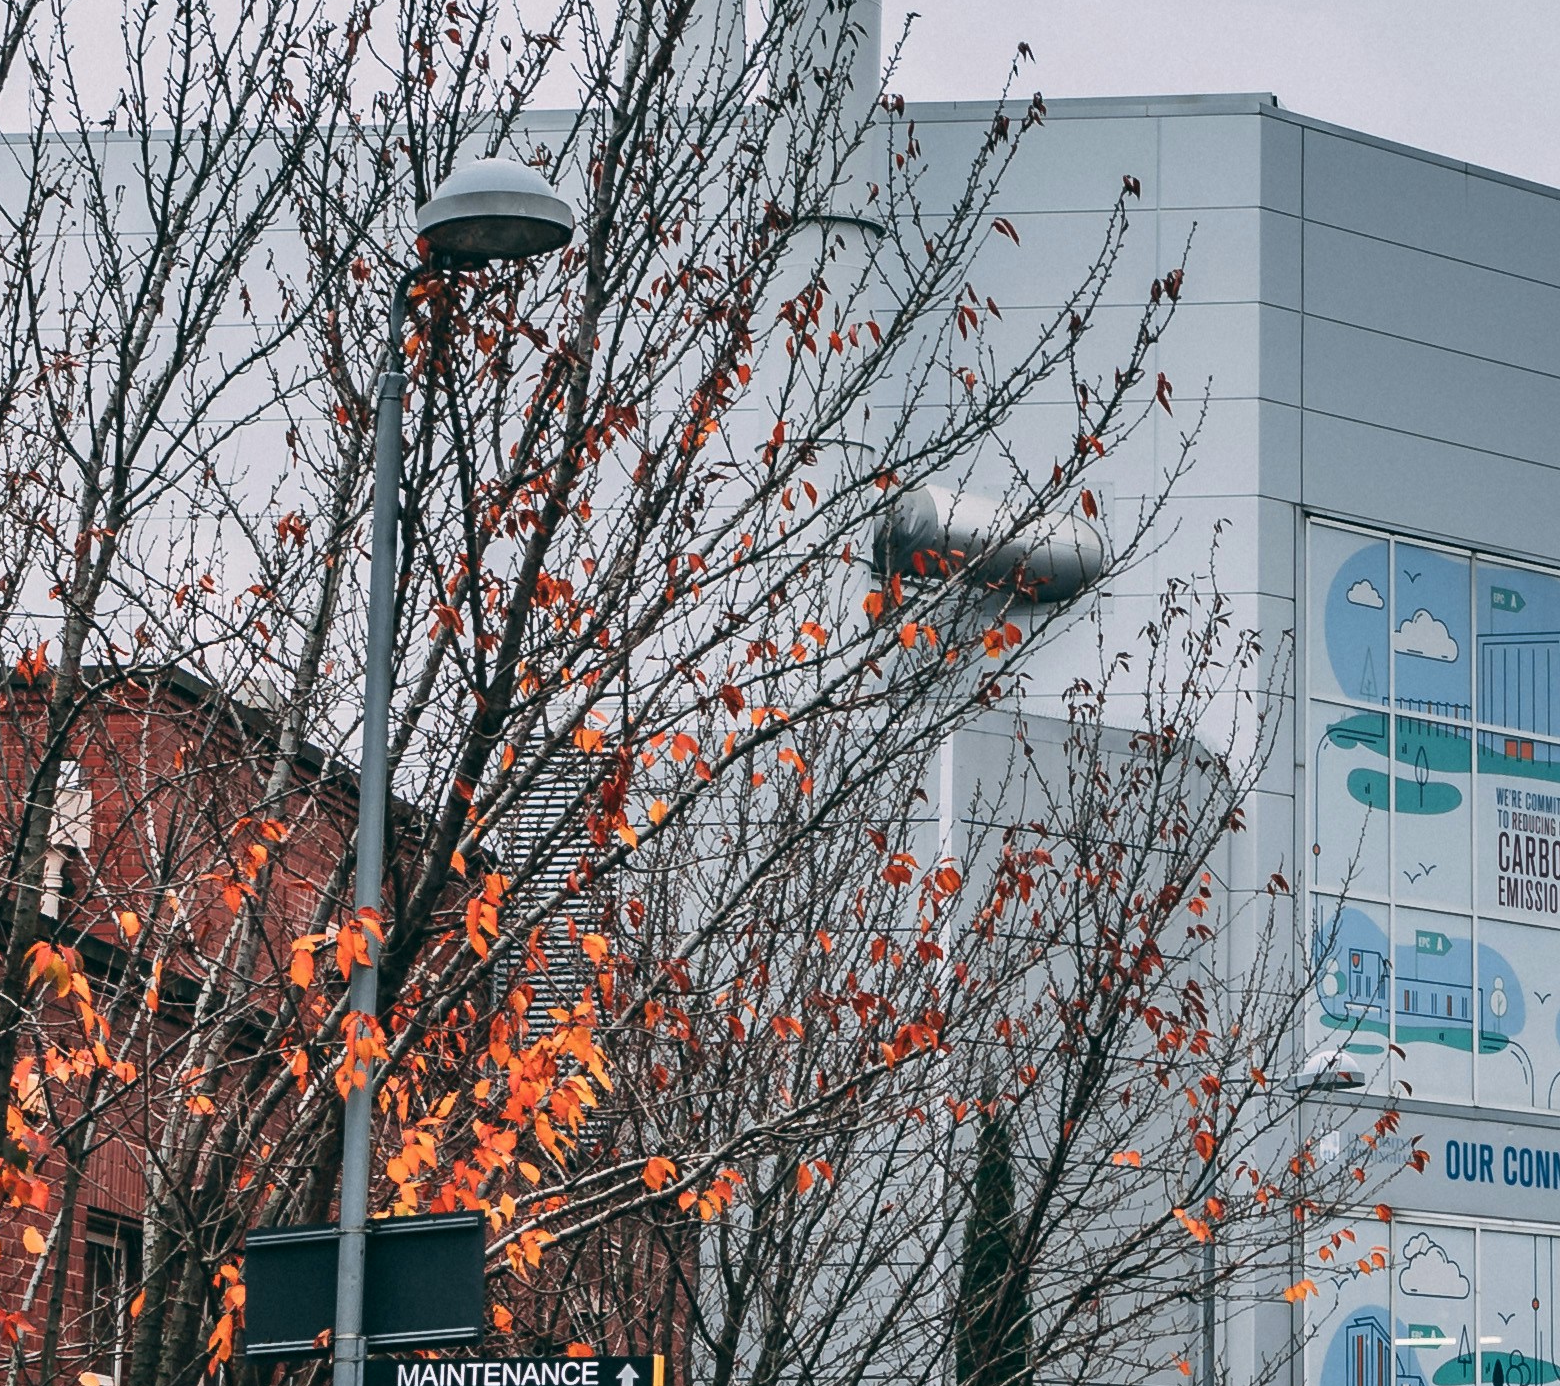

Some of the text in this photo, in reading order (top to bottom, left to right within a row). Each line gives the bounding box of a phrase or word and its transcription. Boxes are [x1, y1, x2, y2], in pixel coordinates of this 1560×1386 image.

[1510, 594, 1517, 608] A
[1496, 787, 1522, 809] WE'RE
[1497, 809, 1509, 829] TO
[1512, 812, 1556, 837] REDUCING
[1437, 936, 1443, 951] A
[1446, 1140, 1495, 1183] OUR
